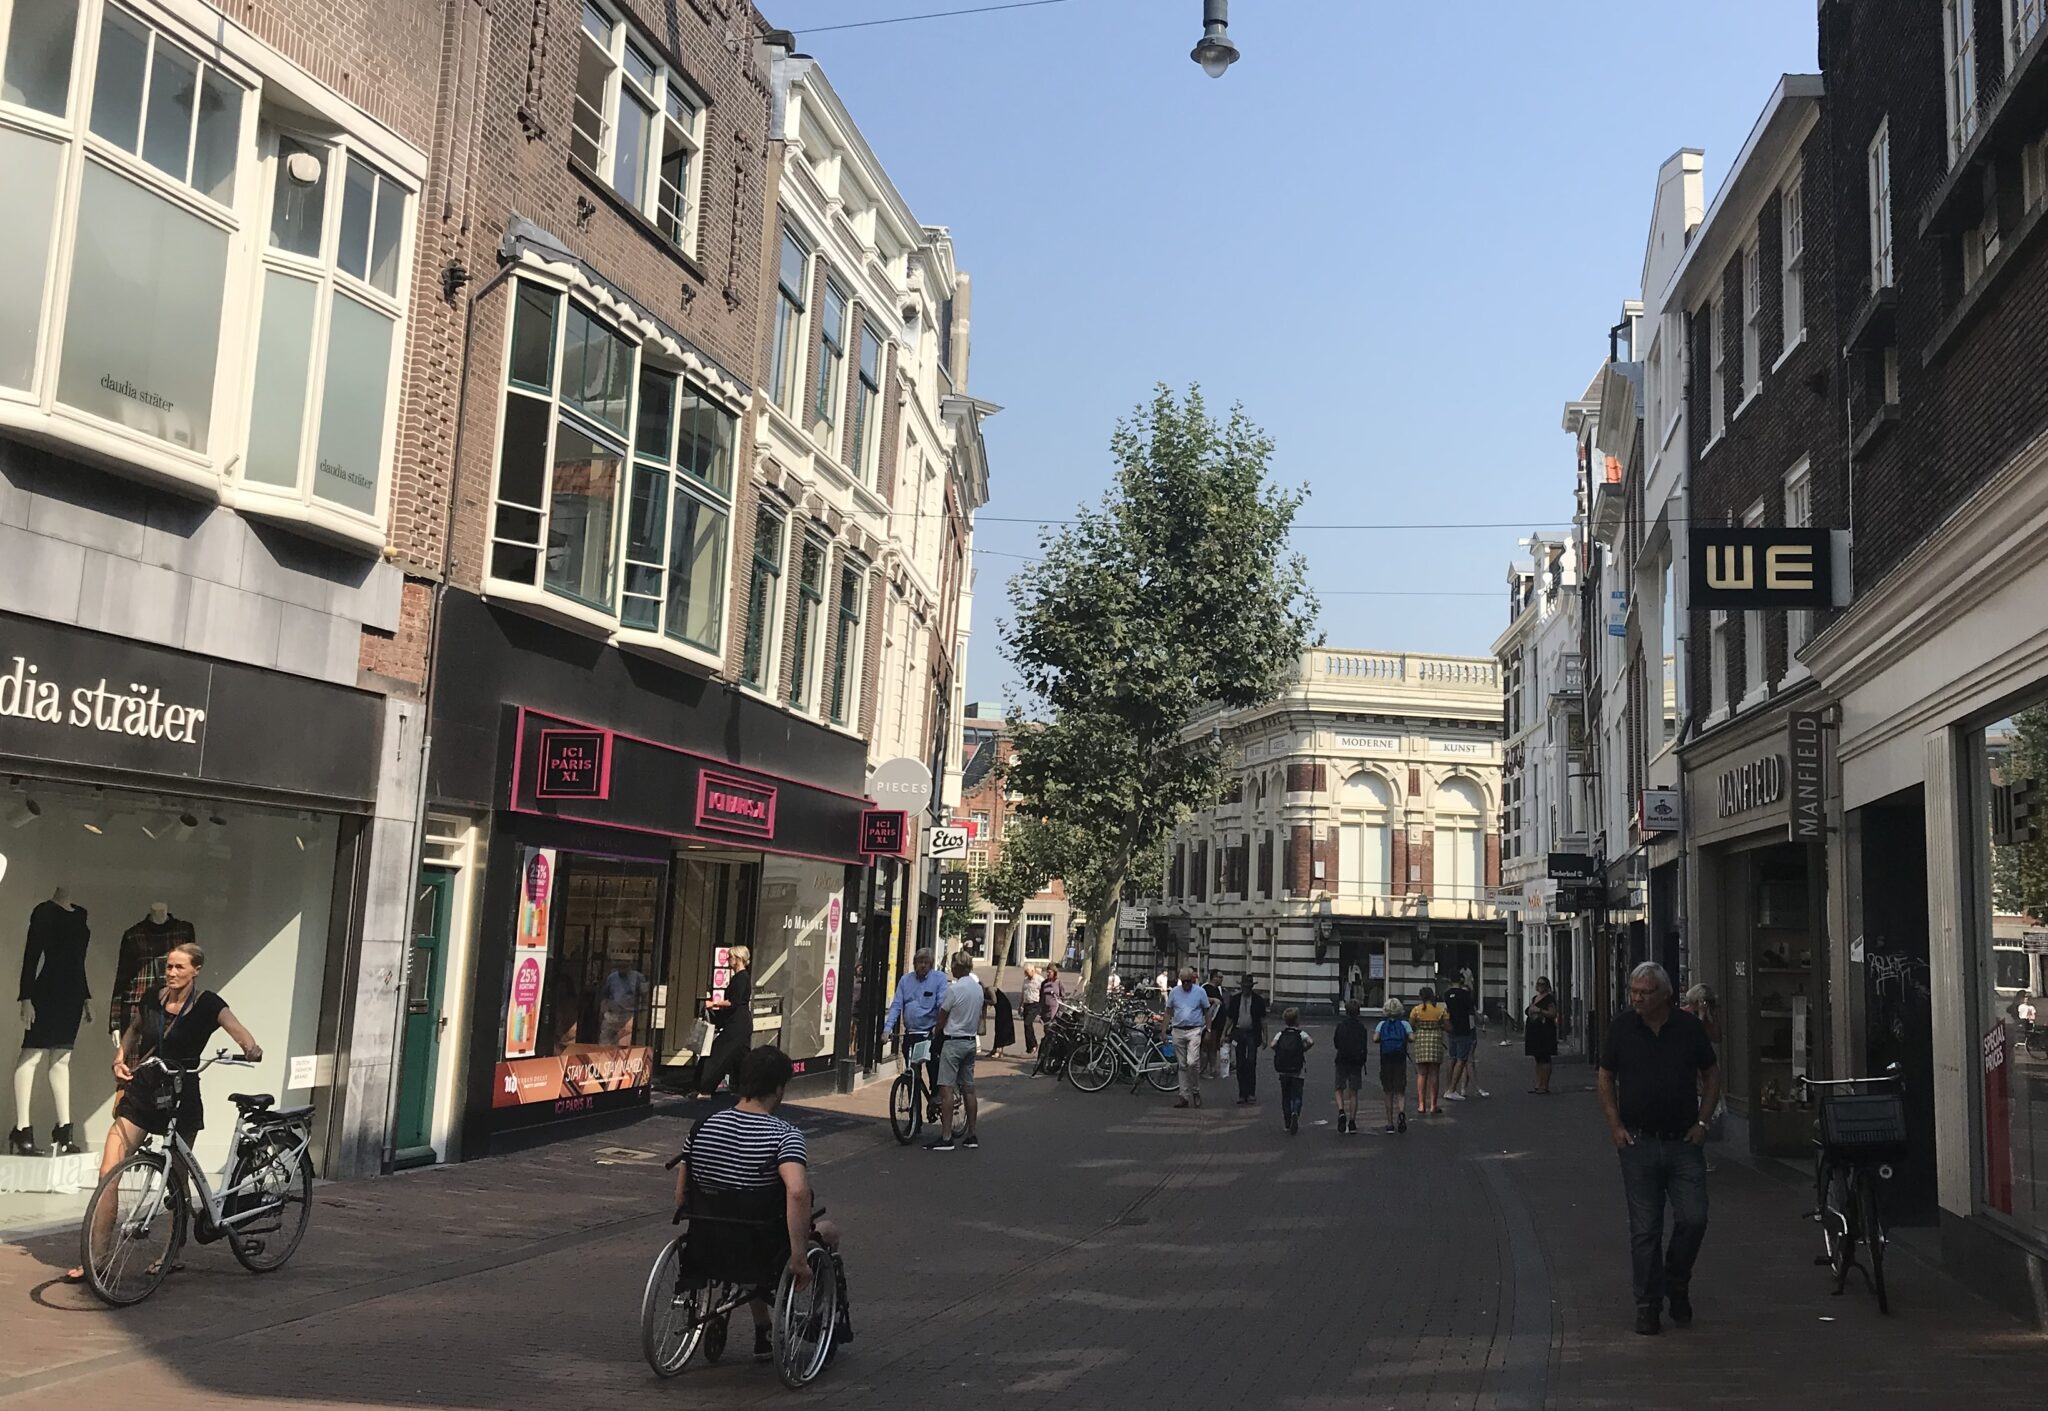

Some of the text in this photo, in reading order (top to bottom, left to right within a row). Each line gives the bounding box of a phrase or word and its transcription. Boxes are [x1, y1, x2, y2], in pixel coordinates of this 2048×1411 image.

[100, 373, 174, 412] claudia sträter
[320, 458, 373, 490] claudia sträter
[1706, 545, 1813, 590] WE
[0, 656, 205, 744] dia sträter
[1341, 738, 1393, 749] MODERNE
[1443, 743, 1477, 753] KUNST
[562, 747, 583, 758] ICI
[551, 759, 592, 770] PARIS
[561, 771, 579, 782] XL
[1797, 717, 1818, 836] MANFIELD
[876, 782, 928, 794] PIECES
[1717, 753, 1782, 819] MANFIELD
[876, 820, 890, 828] ICI
[869, 828, 896, 836] PARIS
[932, 830, 964, 848] Etos
[876, 836, 888, 844] XL
[520, 968, 537, 984] 25%
[565, 1064, 584, 1082] STAY
[603, 1060, 620, 1076] STAY
[565, 1098, 584, 1112] PARIS
